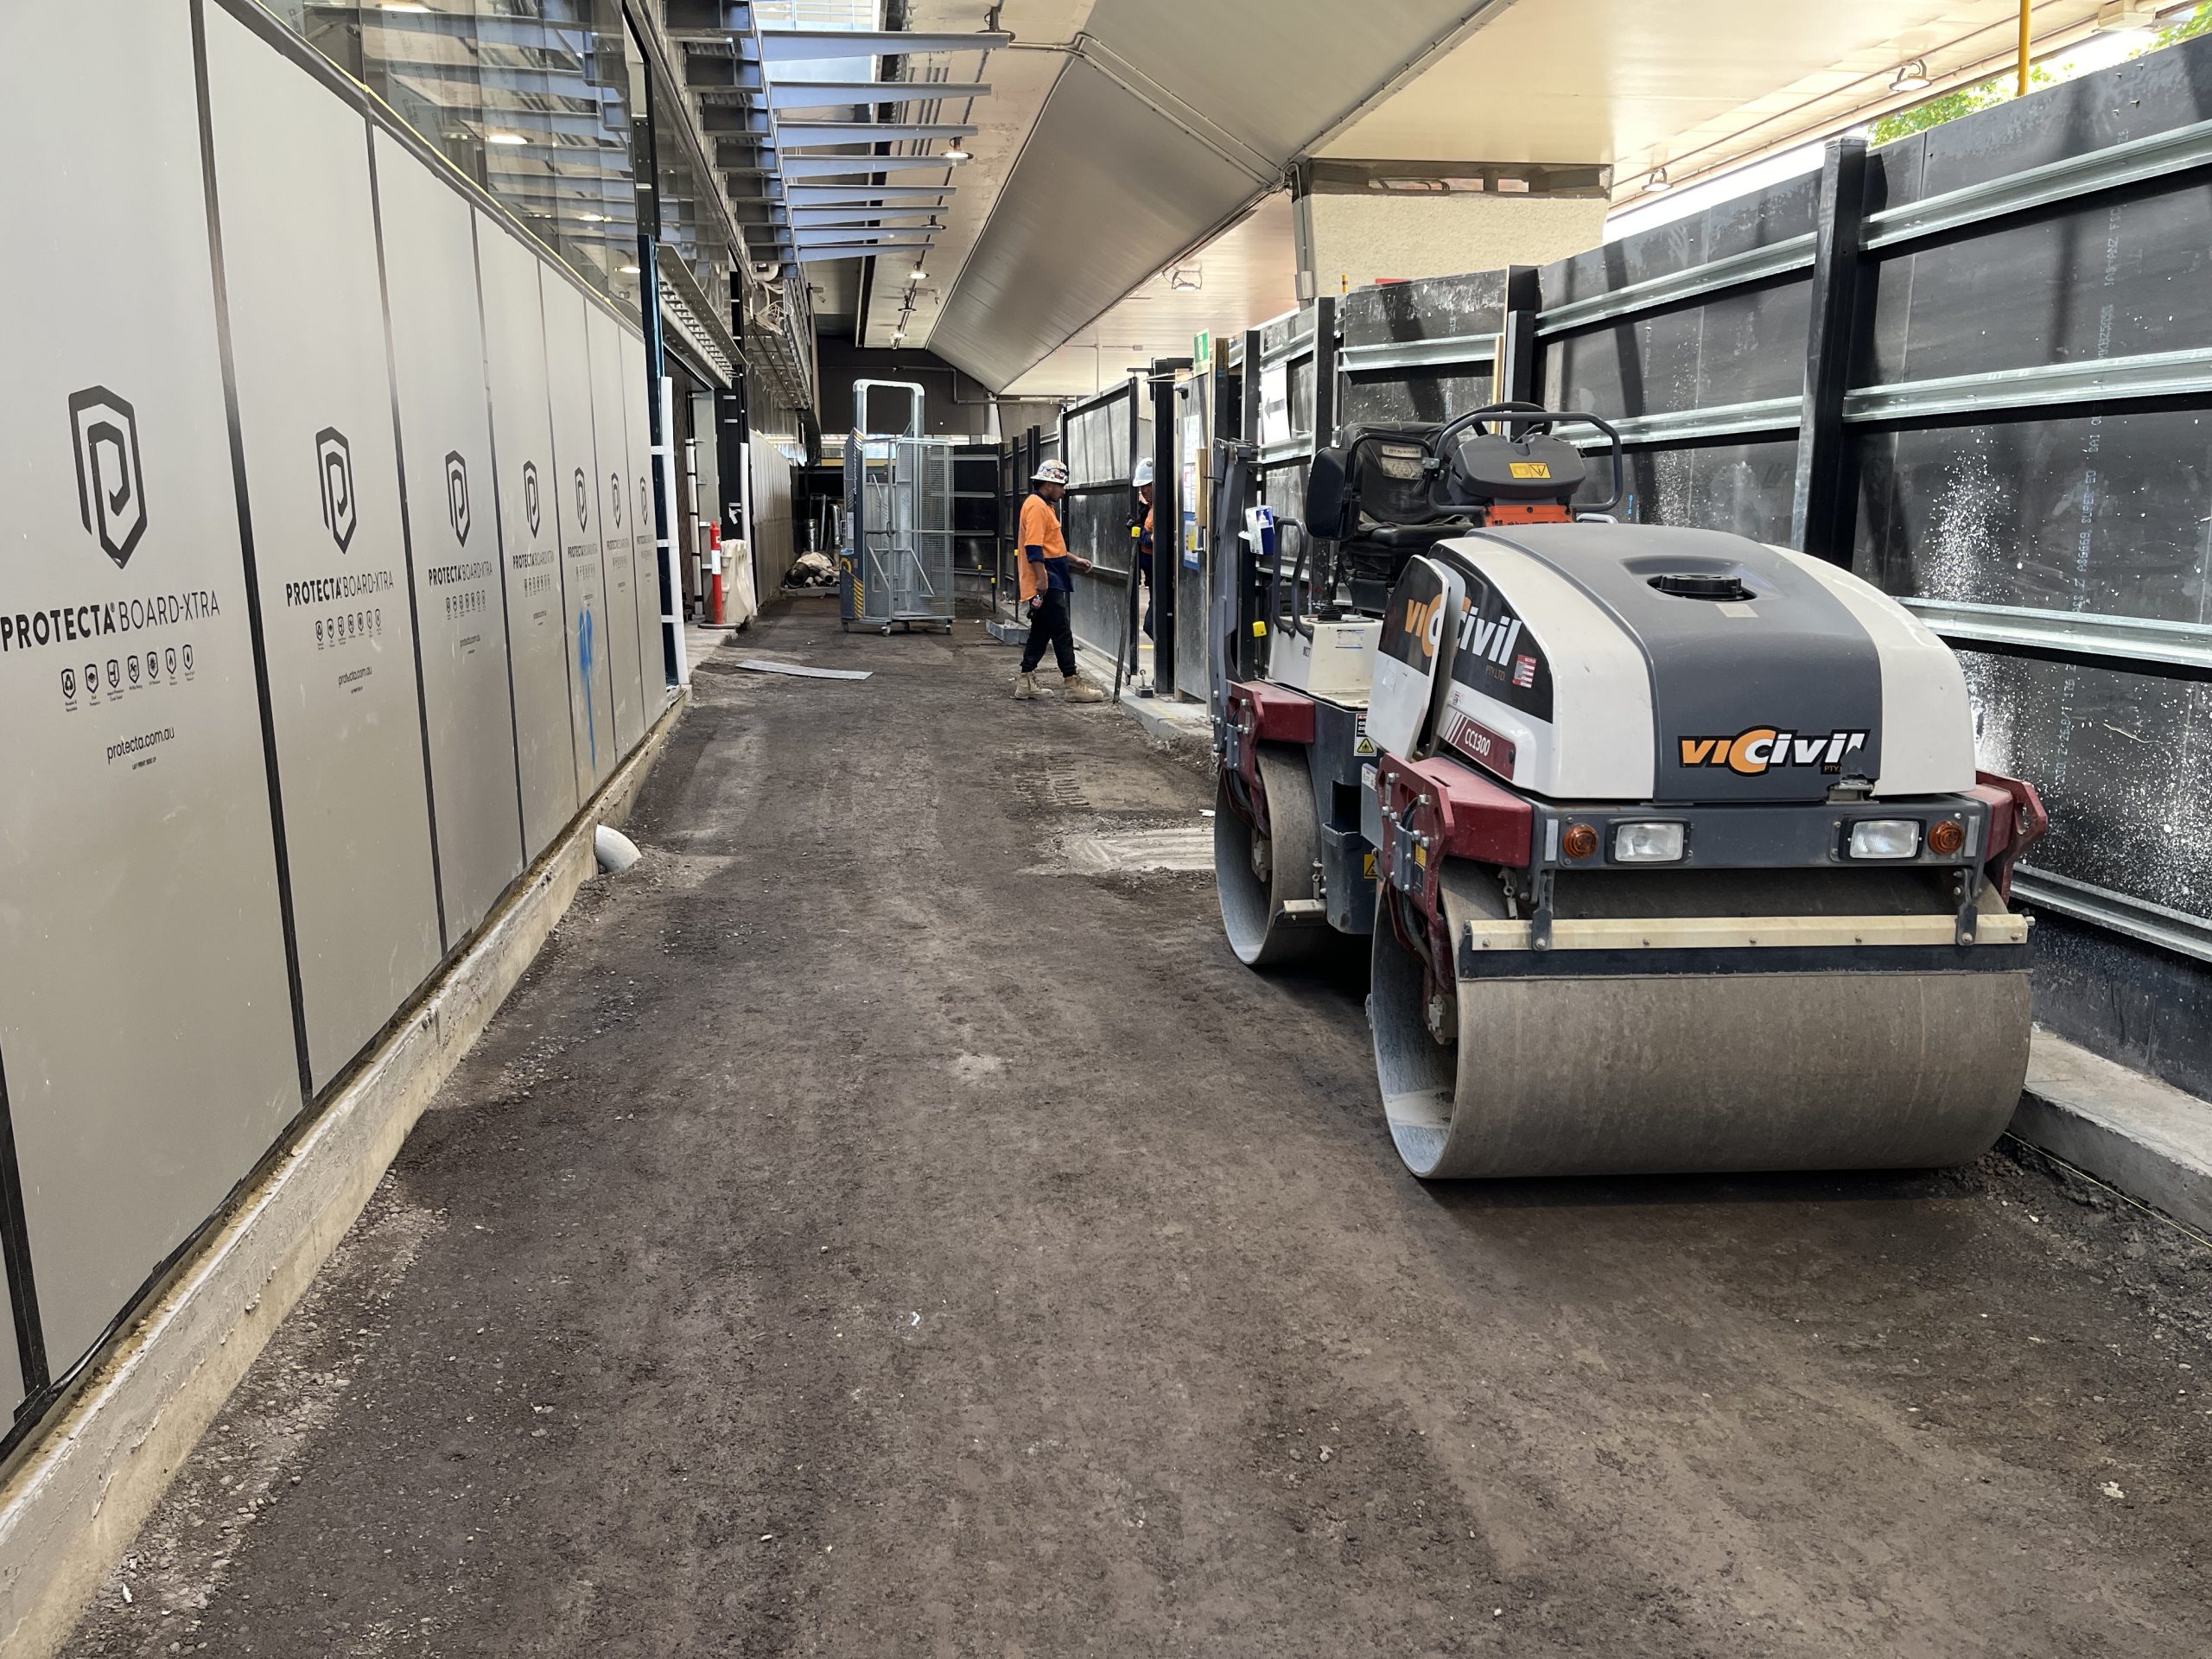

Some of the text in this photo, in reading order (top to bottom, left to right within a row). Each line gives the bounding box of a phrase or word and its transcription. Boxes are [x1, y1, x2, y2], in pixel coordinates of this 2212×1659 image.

[286, 570, 394, 607] PROTECTA BOARD-XTRA
[429, 564, 461, 587] PROTECTA
[0, 590, 220, 652] PROTECTA BOARD-XTRA
[107, 727, 175, 765] protecta.com.au
[1465, 728, 1491, 756] CC1300
